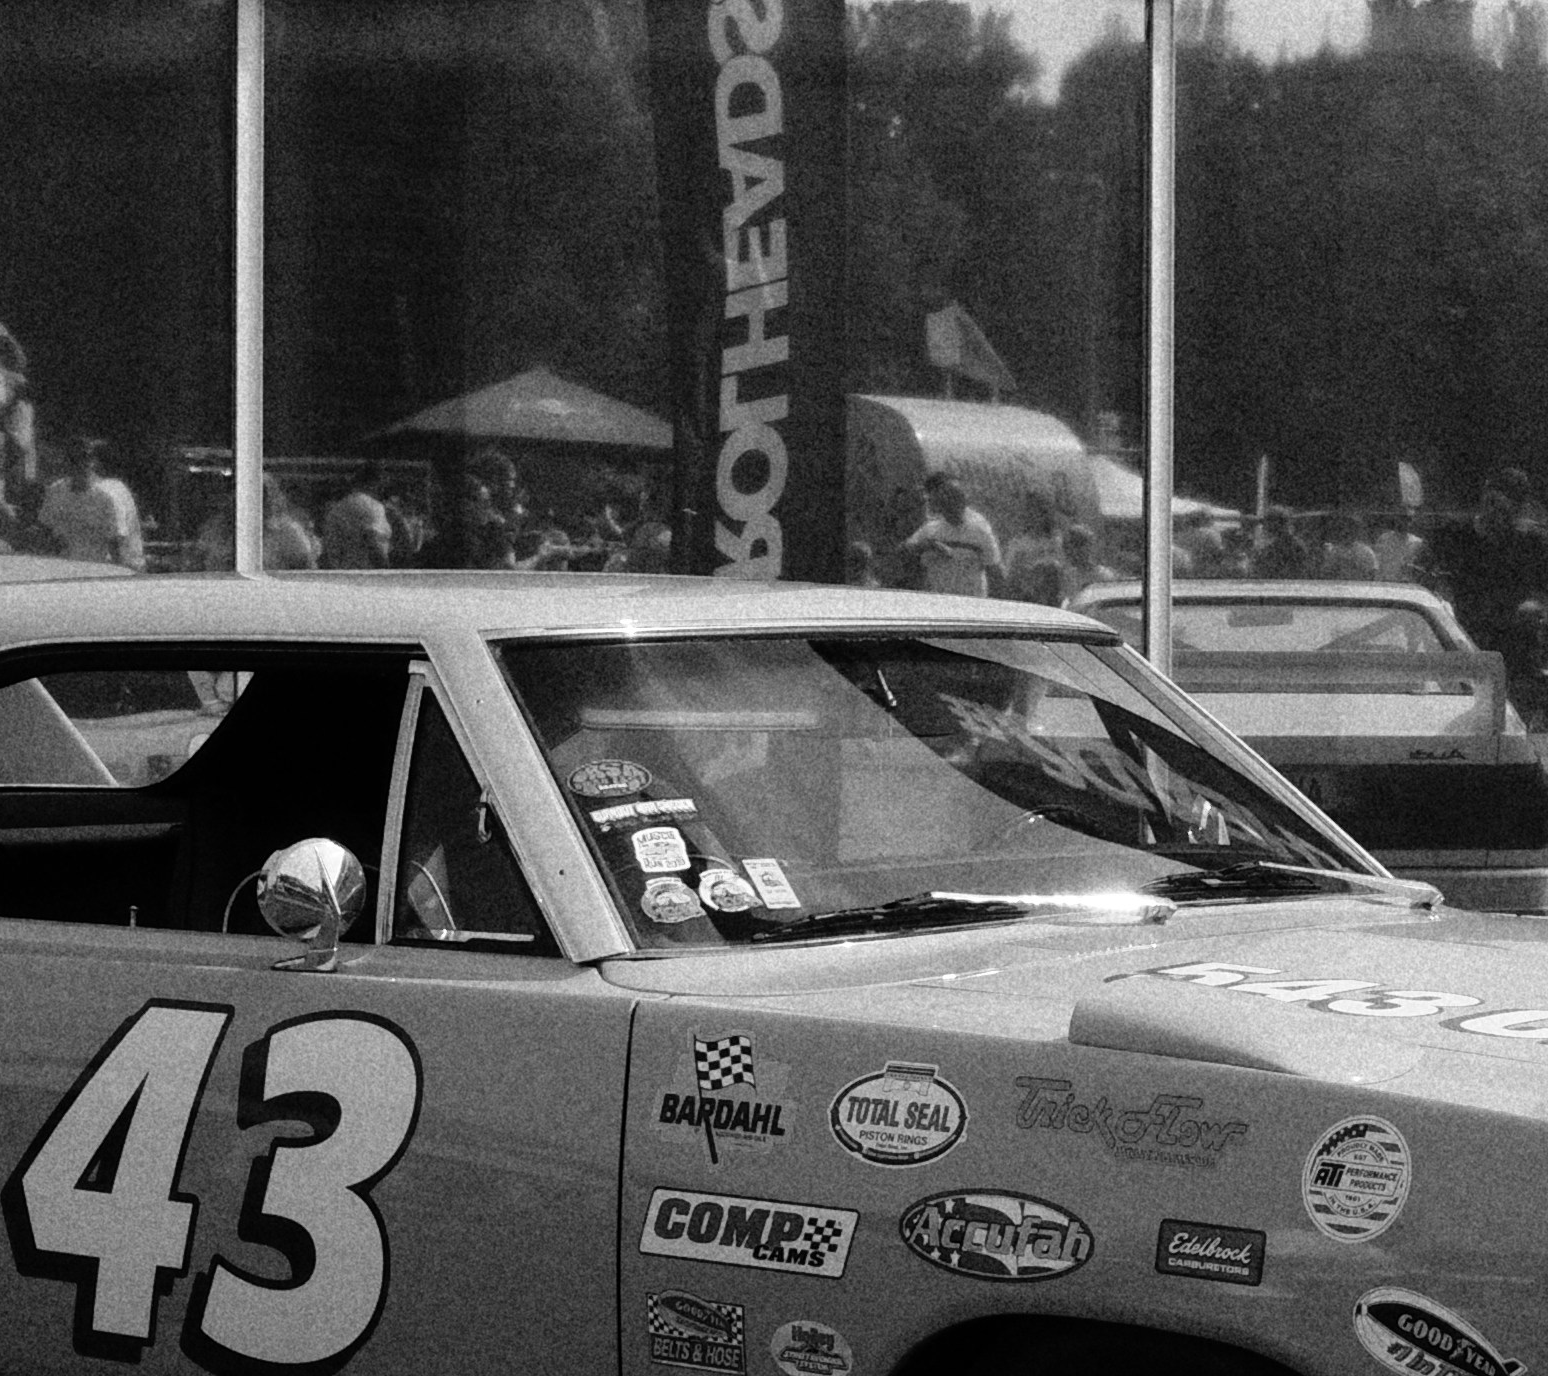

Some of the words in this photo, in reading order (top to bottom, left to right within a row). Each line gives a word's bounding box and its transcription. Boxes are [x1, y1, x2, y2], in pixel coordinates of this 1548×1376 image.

[659, 1093, 786, 1136] BARDAHL
[847, 1096, 899, 1128] TOTAL
[905, 1100, 951, 1133] SEAL
[859, 1129, 896, 1142] PISTON
[897, 1134, 928, 1146] RINGS
[1314, 1162, 1347, 1187] ATI
[1345, 1166, 1400, 1182] PERFORMANCE
[1350, 1178, 1388, 1192] PRODUCTS
[653, 1197, 806, 1249] COMP
[752, 1243, 827, 1268] CAMS
[1168, 1231, 1253, 1264] Edelbrock
[1168, 1257, 1250, 1276] CARBURETORS
[653, 1336, 691, 1360] BELTS
[693, 1343, 703, 1362] &
[705, 1345, 740, 1367] HOSE
